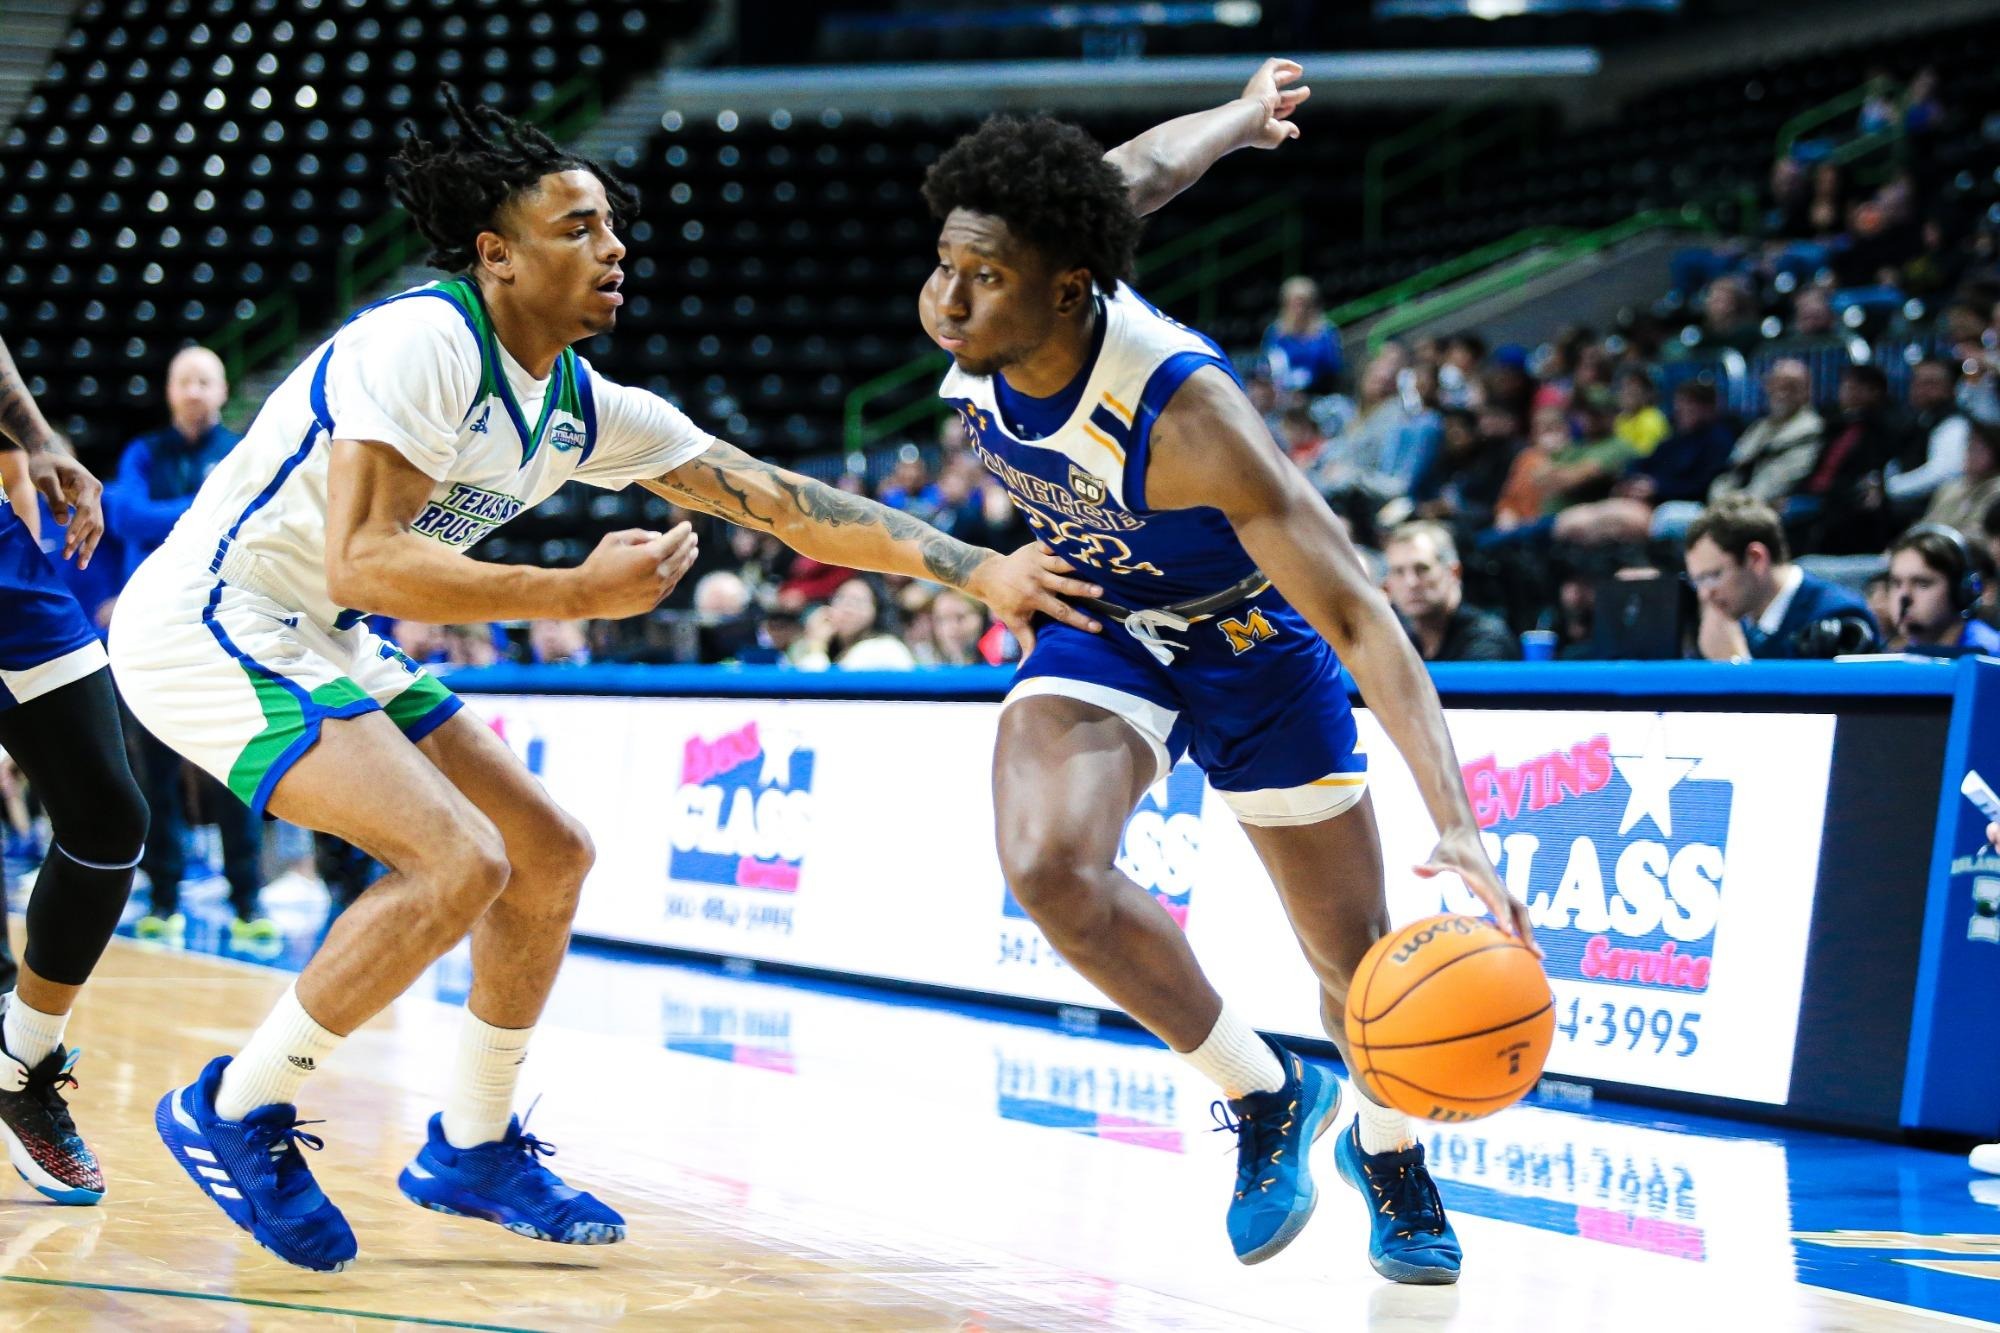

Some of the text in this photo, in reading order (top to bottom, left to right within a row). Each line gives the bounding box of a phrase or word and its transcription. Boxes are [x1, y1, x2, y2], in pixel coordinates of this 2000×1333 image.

[446, 485, 506, 520] TEXAS
[1074, 478, 1099, 500] 60
[412, 505, 481, 543] RPUS
[1217, 606, 1279, 656] M
[1462, 734, 1615, 831] EVINS
[1581, 935, 1712, 989] Service
[1554, 996, 1702, 1058] 4-3995
